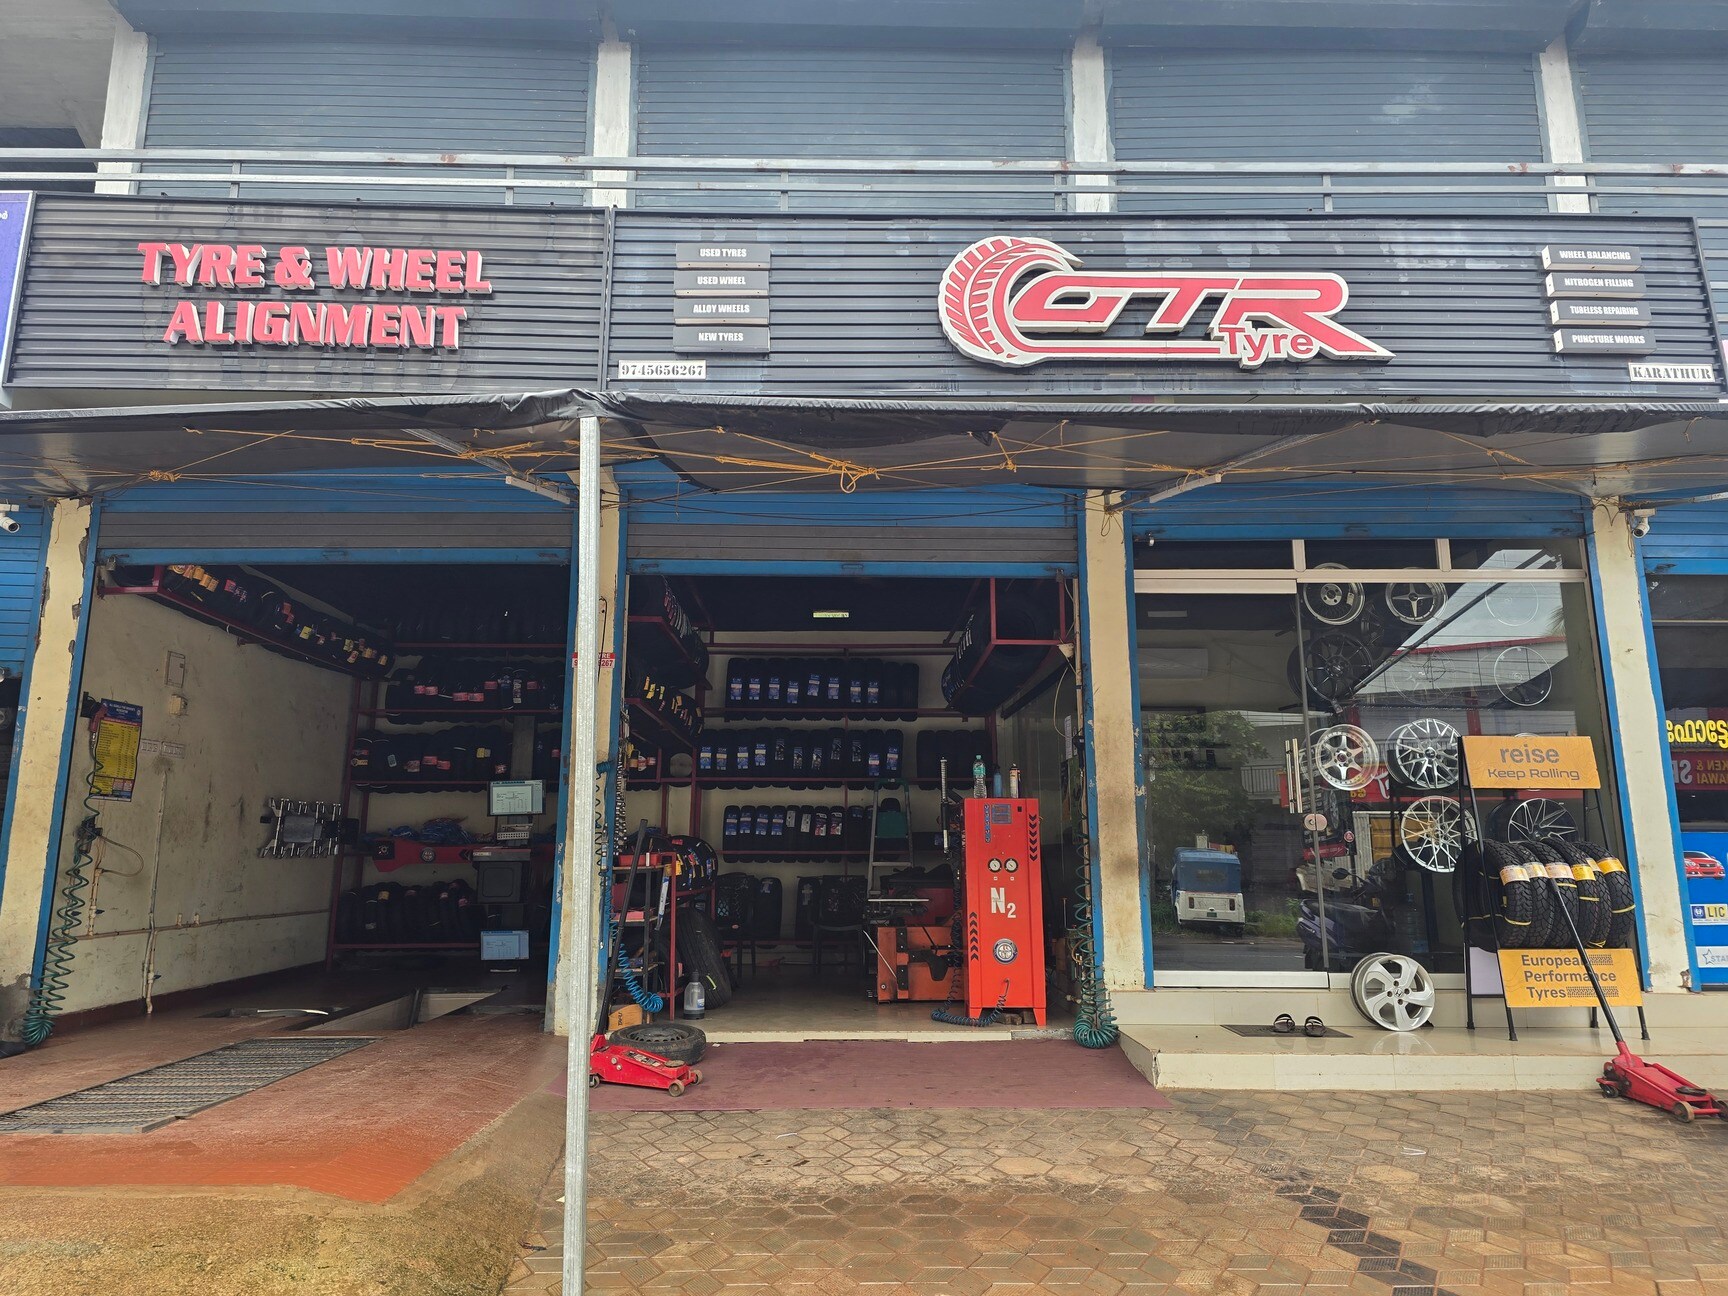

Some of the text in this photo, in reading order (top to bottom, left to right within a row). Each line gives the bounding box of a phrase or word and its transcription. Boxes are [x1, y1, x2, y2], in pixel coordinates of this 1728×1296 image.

[700, 248, 747, 258] USED TYRES
[1559, 250, 1631, 260] WHEEL BALANCING
[137, 242, 493, 295] TYRE & WHEEL
[697, 276, 746, 285] USED WHEEL
[1564, 277, 1634, 288] NITROGEN FILLING
[693, 304, 750, 313] ALLOY WHEELS
[1569, 305, 1639, 316] TUBELESS REPAIRING
[163, 300, 468, 350] ALIGNMENT
[698, 332, 744, 342] NEW TYRES
[1572, 334, 1646, 344] PUNCTURE WORKS
[1217, 326, 1316, 366] Tyre
[621, 364, 704, 376] 9745656267
[1632, 366, 1712, 380] KARATHUR
[1500, 744, 1560, 764] reise
[1487, 768, 1580, 781] Keep Rolling
[1707, 906, 1725, 917] LIC
[1526, 986, 1566, 1000] Tyres
